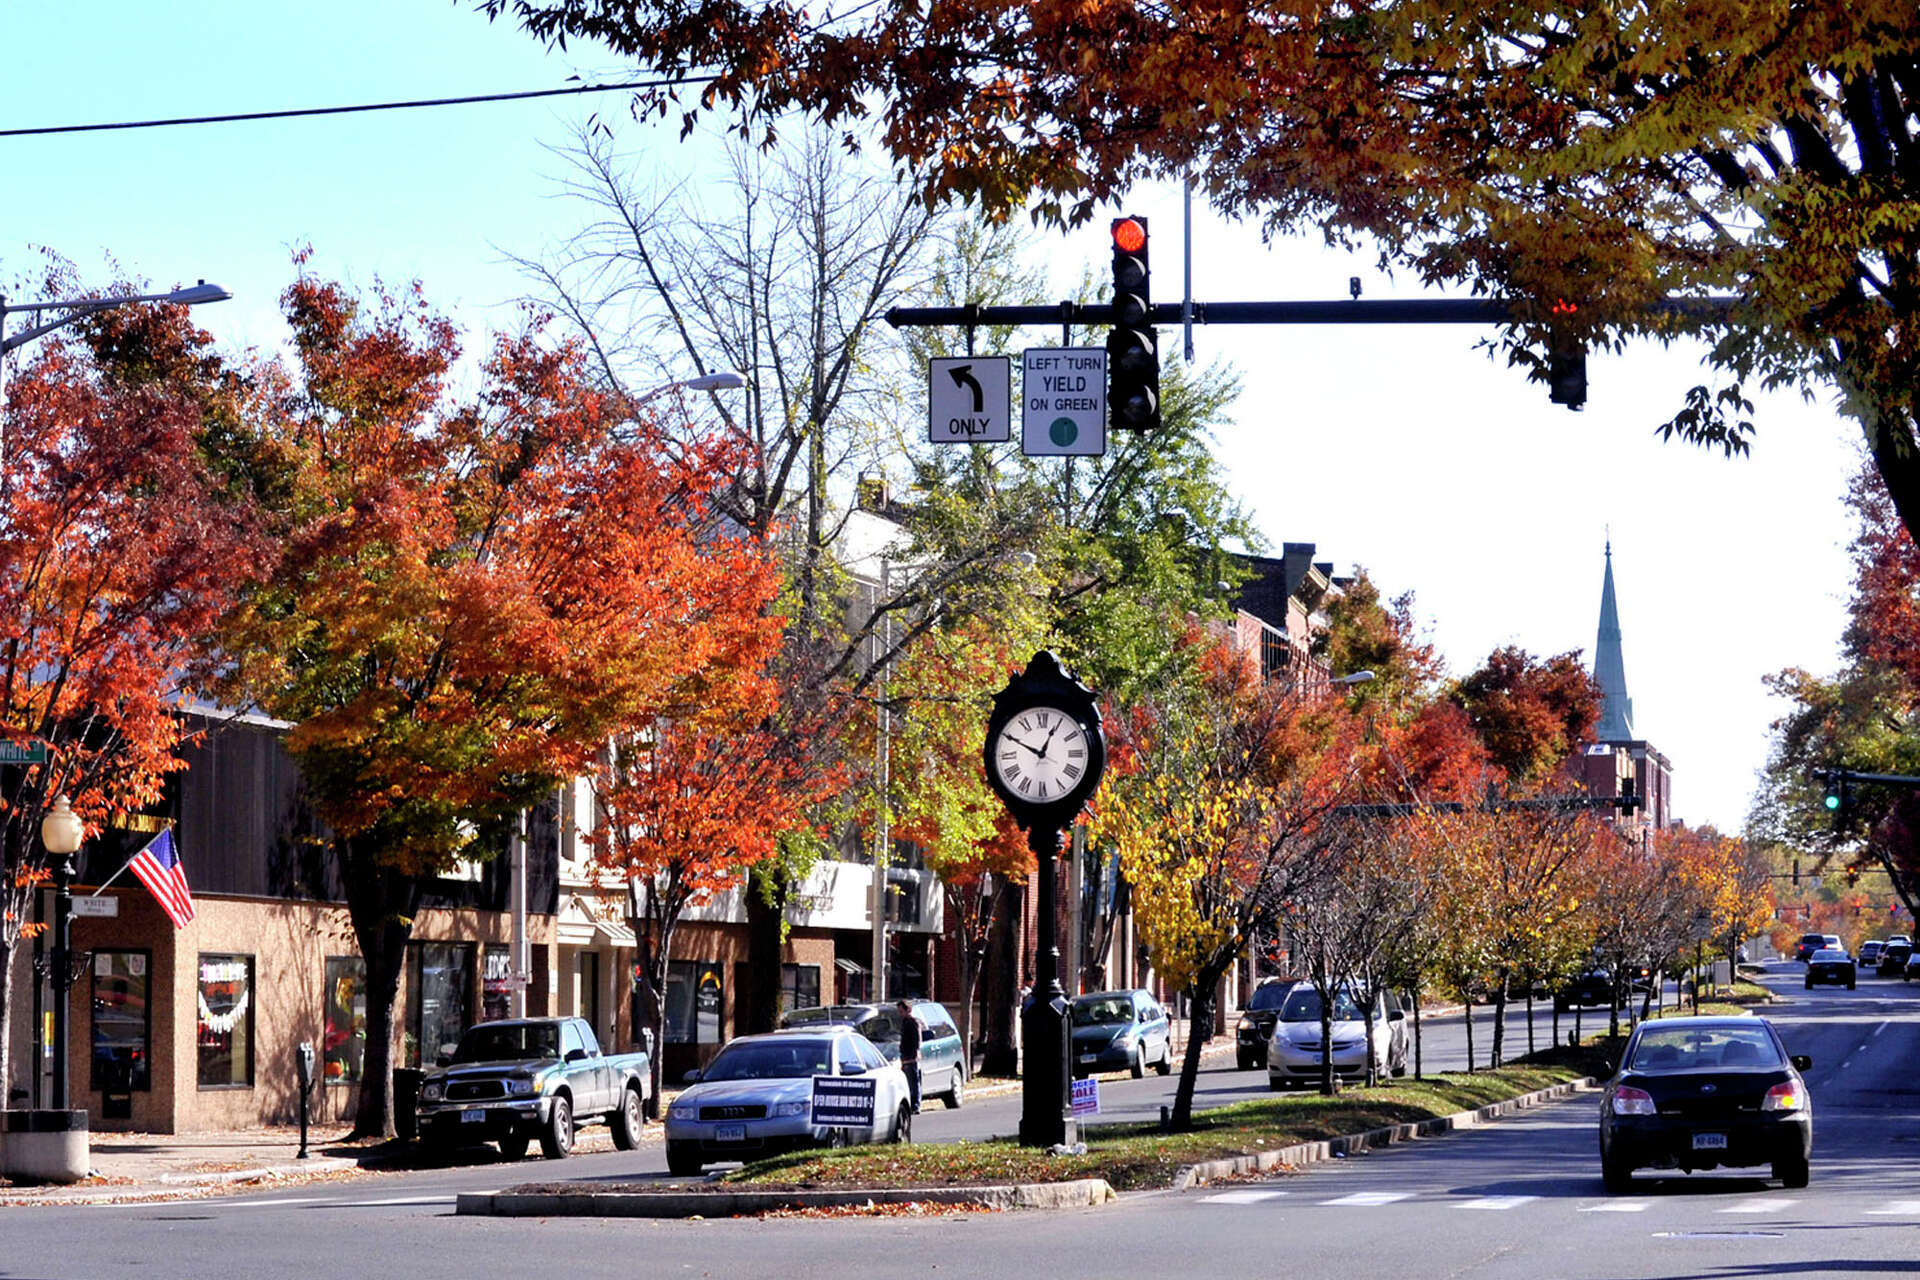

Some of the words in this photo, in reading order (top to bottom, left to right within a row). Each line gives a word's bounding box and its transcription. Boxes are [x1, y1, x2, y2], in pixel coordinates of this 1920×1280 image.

[1028, 357, 1058, 370] LEFT
[1067, 357, 1101, 370] TURN
[1043, 376, 1086, 392] YIELD
[1030, 398, 1048, 411] ON
[1055, 398, 1098, 411] GREEN
[949, 418, 990, 435] ONLY
